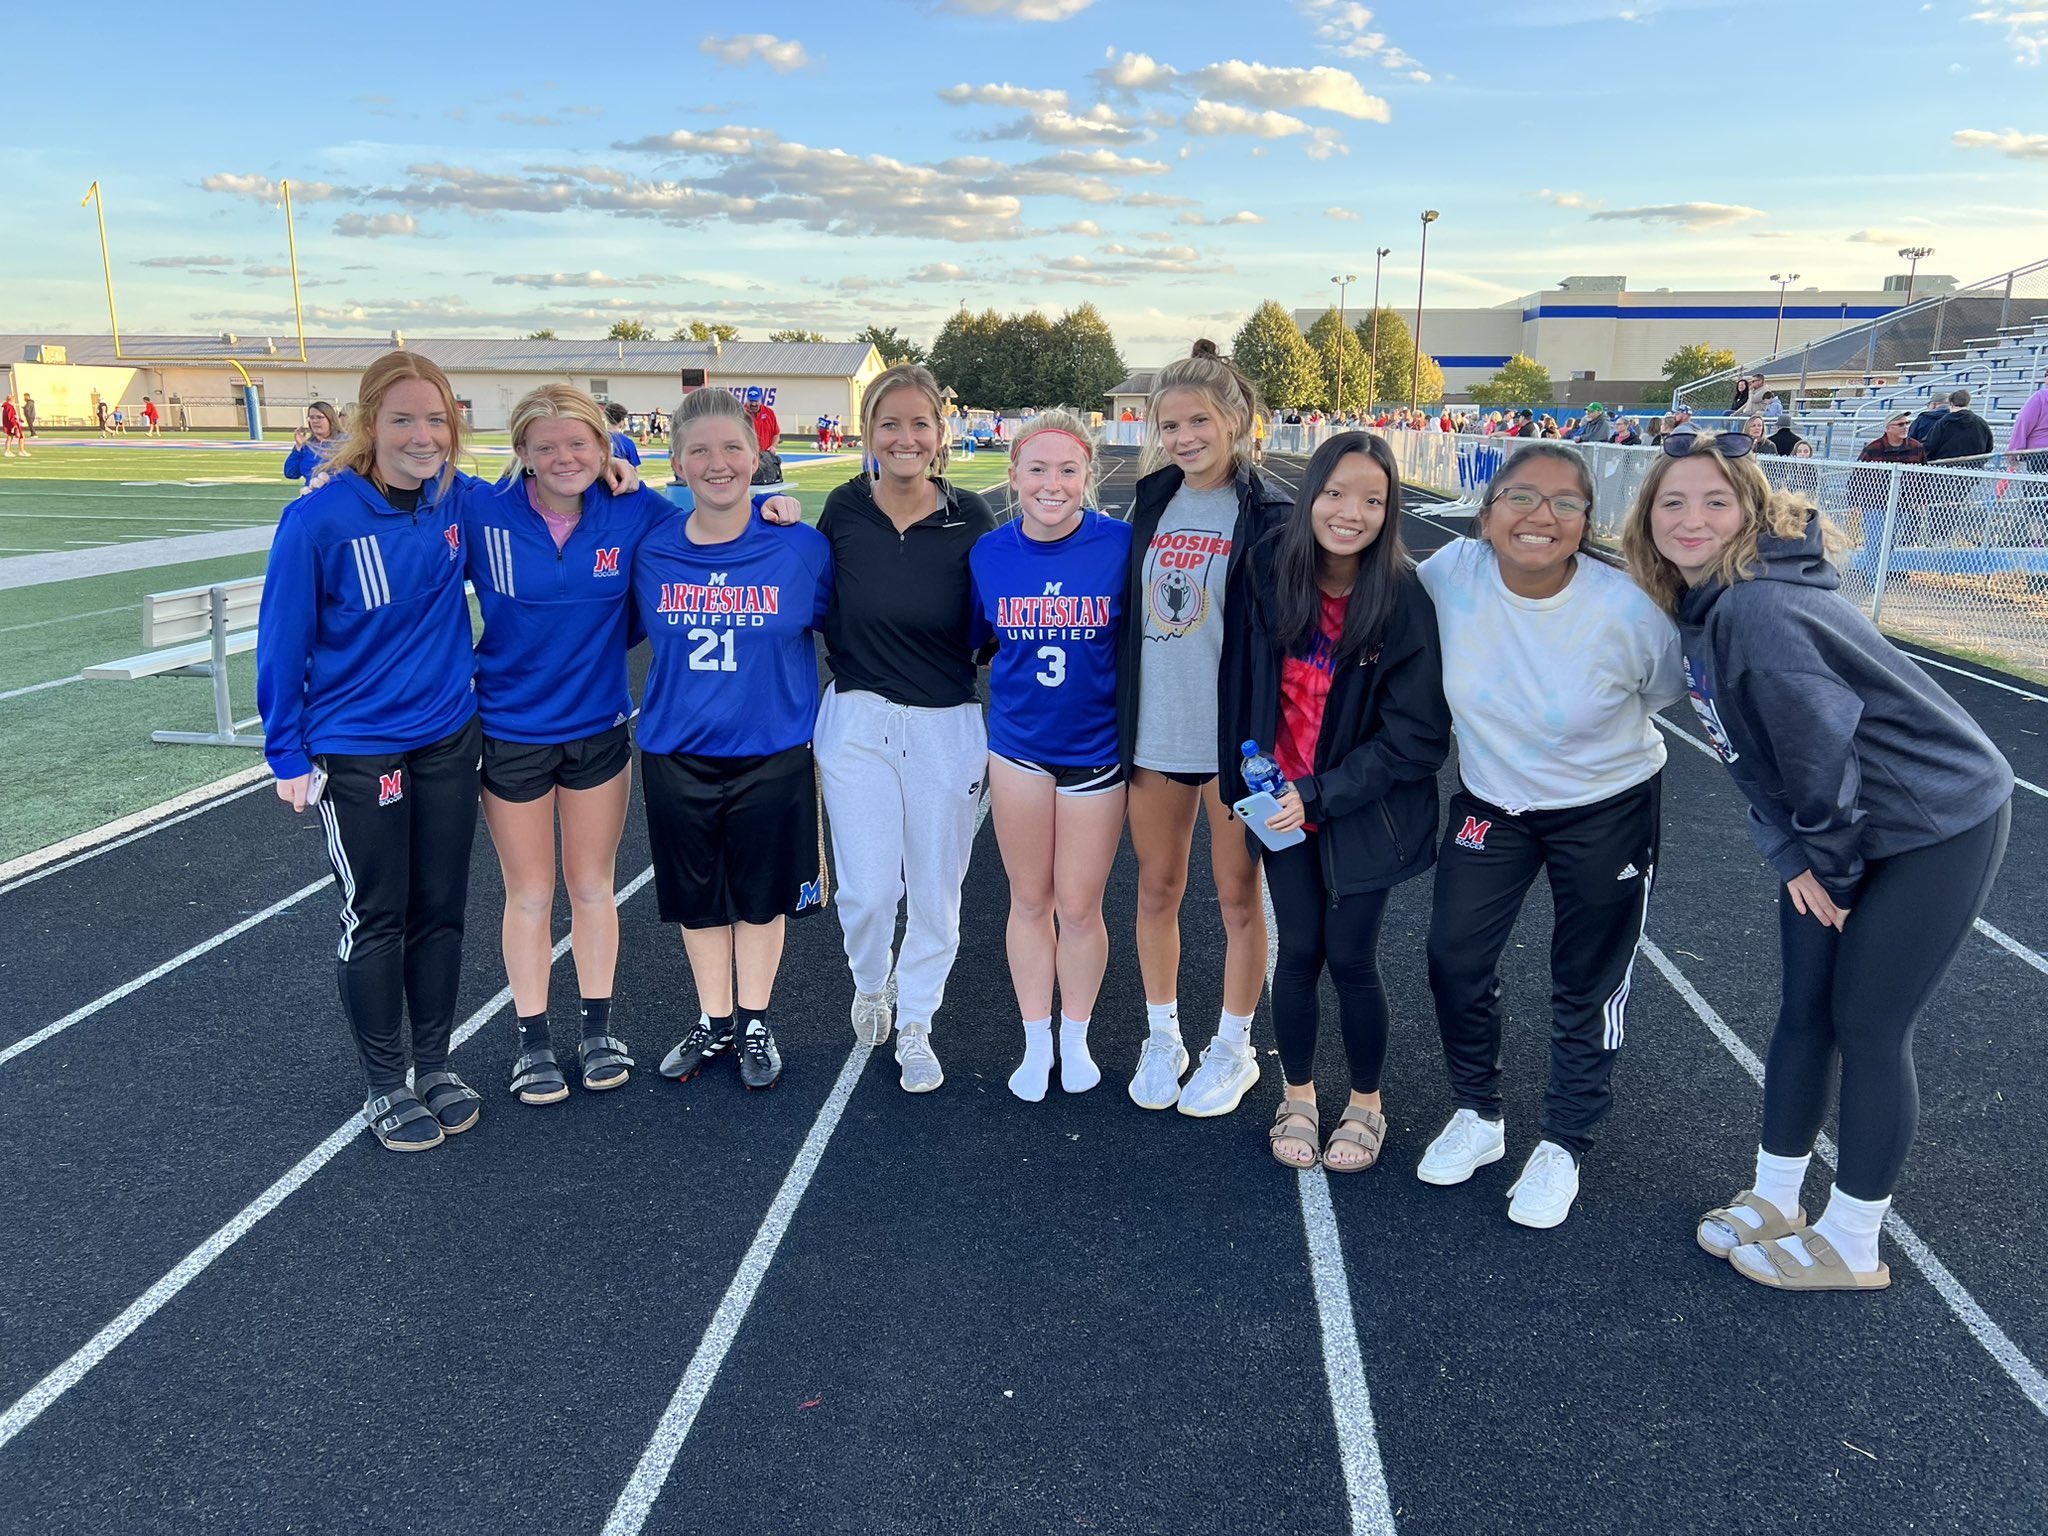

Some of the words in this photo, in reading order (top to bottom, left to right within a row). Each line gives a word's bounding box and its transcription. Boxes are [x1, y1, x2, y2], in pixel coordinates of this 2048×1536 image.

[594, 547, 620, 572] M
[1160, 551, 1205, 569] CUP
[708, 572, 728, 586] M
[1043, 581, 1063, 595] M
[656, 583, 779, 614] ARTESIAN
[997, 596, 1111, 627] ARTESIAN
[667, 613, 764, 627] UNIFIED
[1007, 629, 1096, 640] UNIFIED
[687, 628, 737, 671] 21
[1036, 645, 1066, 687] 3
[379, 769, 402, 800] M
[1457, 816, 1492, 844] M
[796, 872, 821, 911] M
